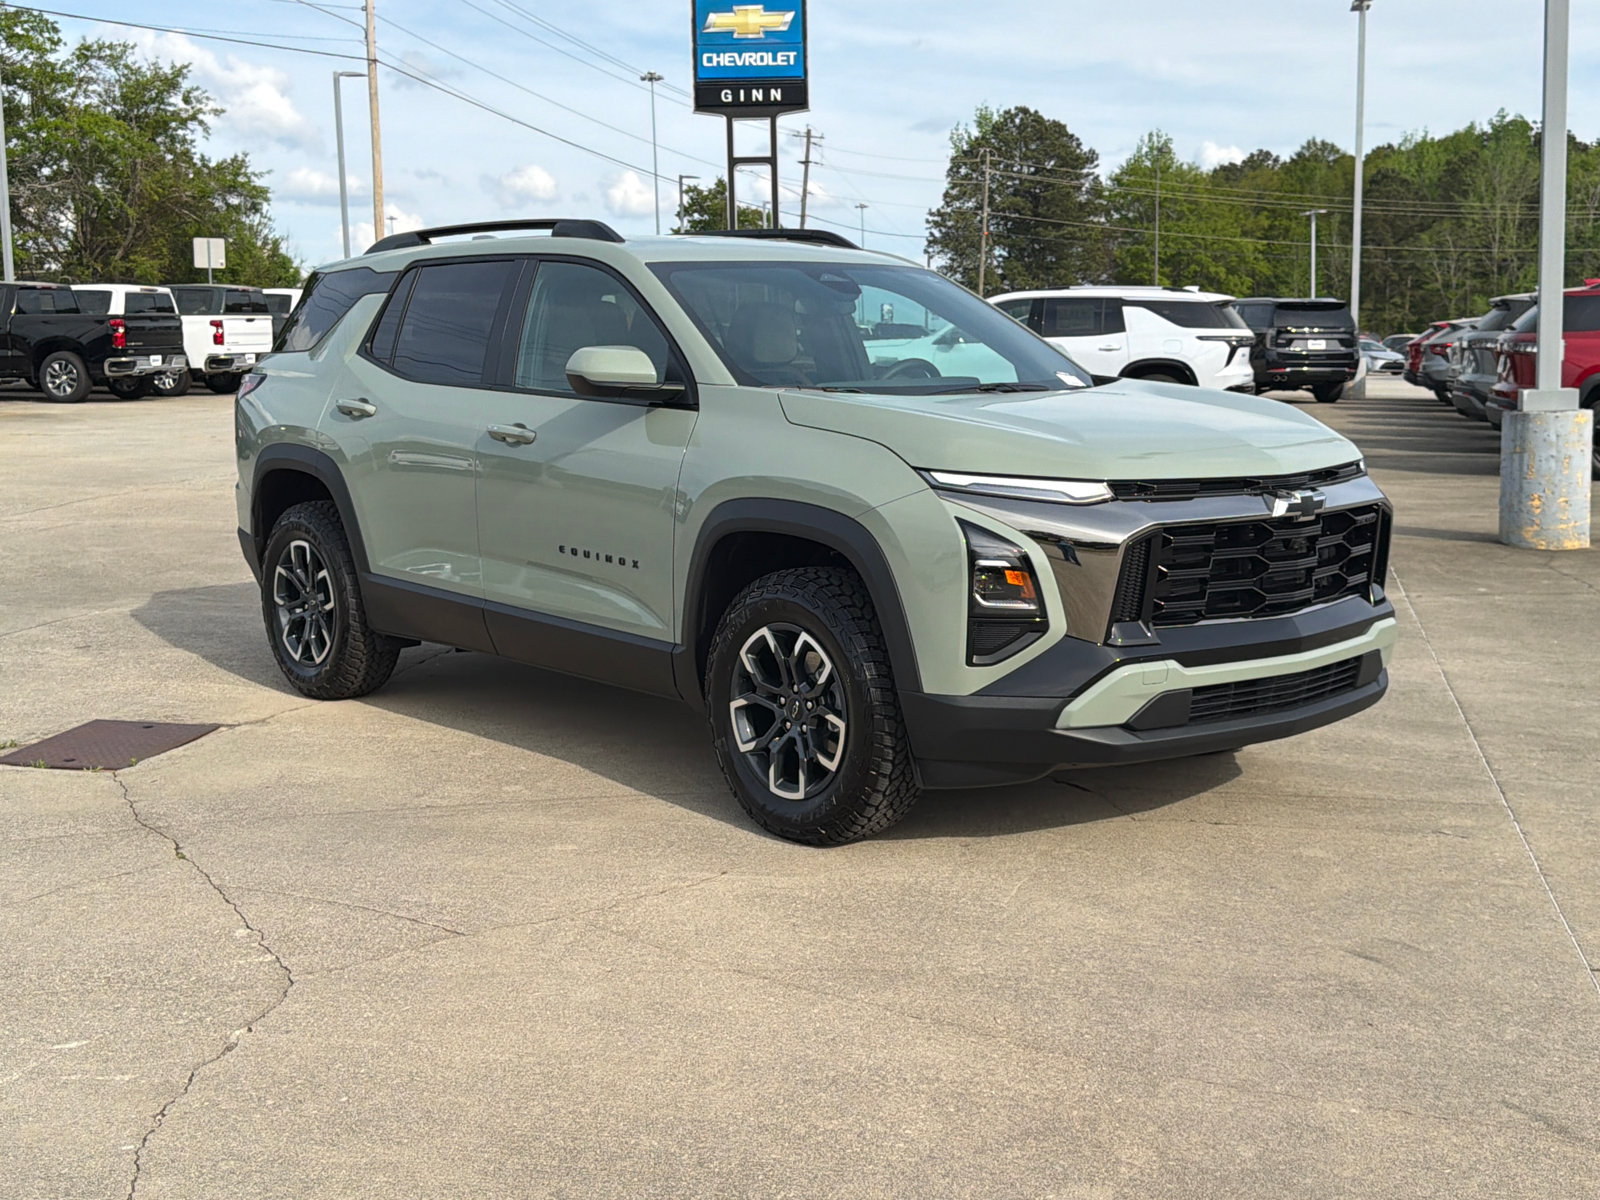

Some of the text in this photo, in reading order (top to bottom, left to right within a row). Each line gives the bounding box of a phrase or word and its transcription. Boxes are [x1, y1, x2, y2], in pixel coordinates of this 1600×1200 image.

[702, 52, 797, 66] CHEVROLET
[721, 88, 781, 102] GINN
[559, 545, 639, 569] EQUINOX
